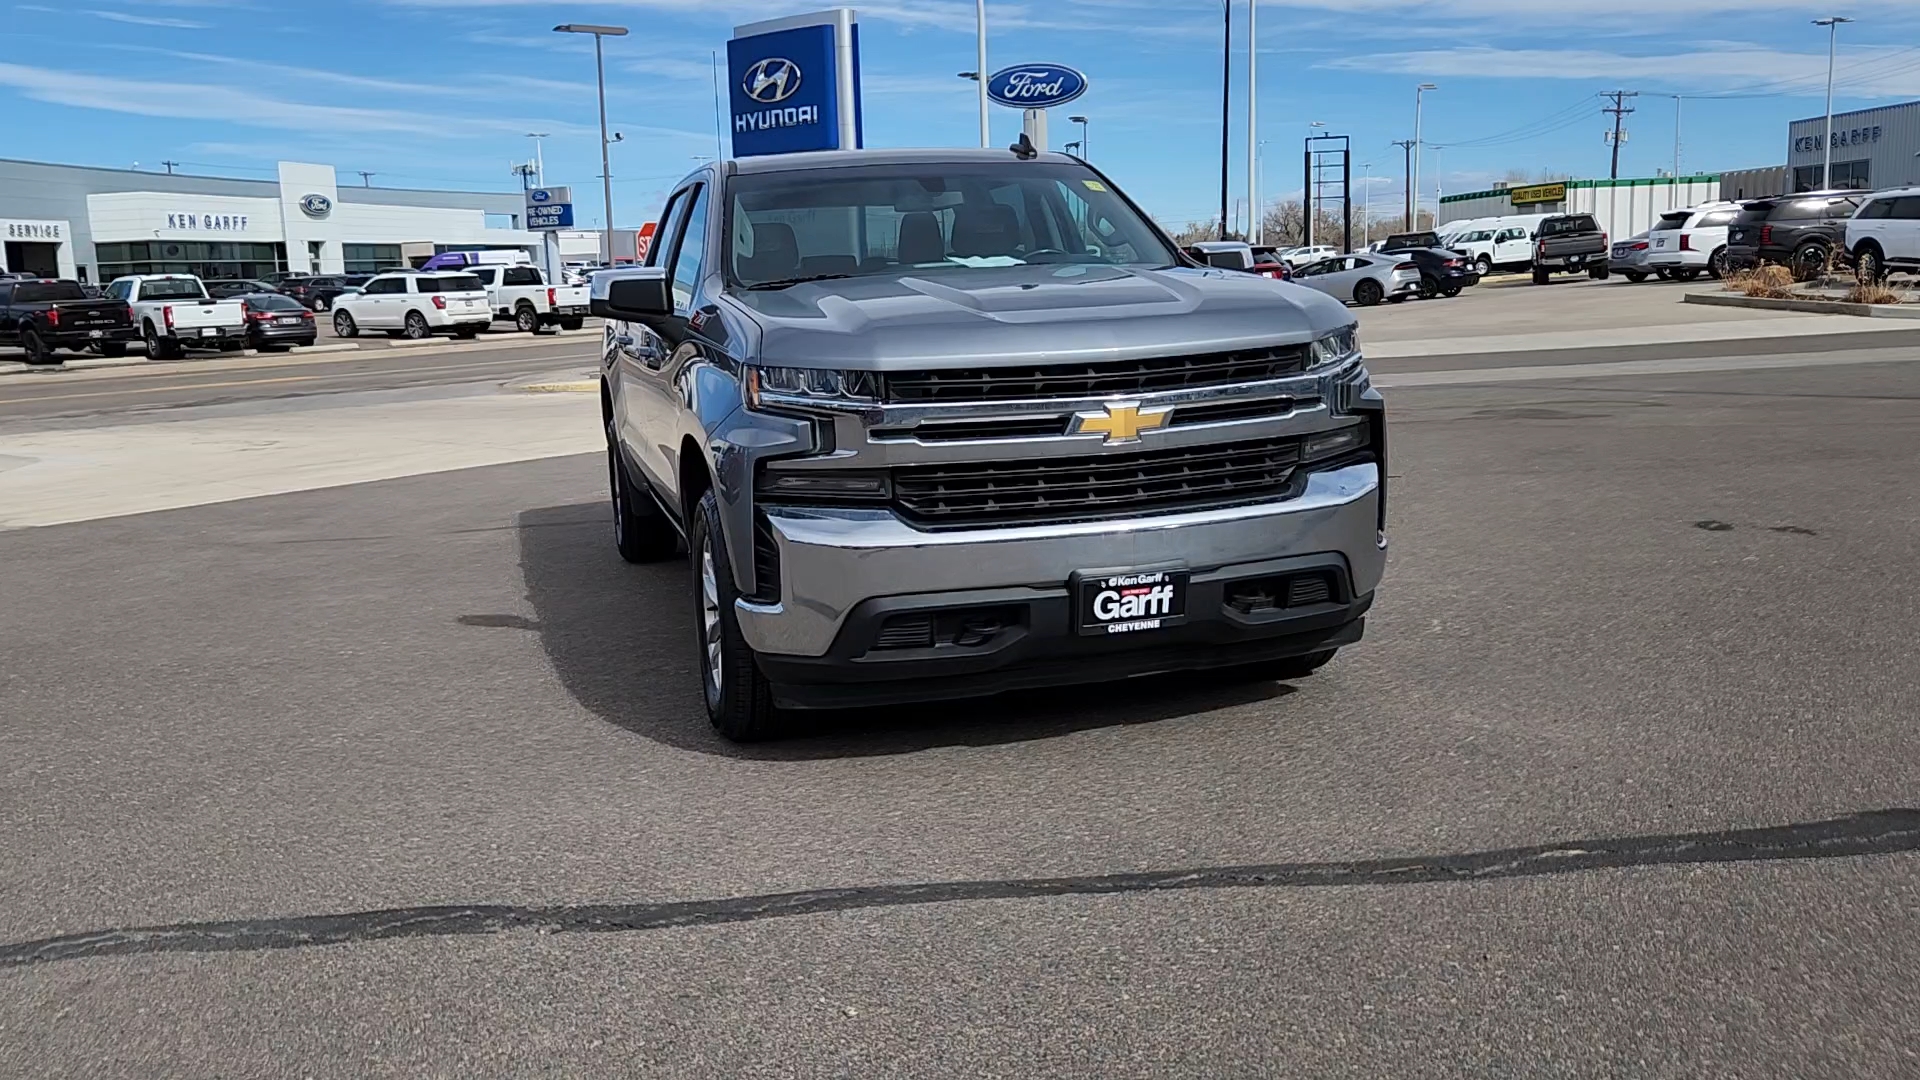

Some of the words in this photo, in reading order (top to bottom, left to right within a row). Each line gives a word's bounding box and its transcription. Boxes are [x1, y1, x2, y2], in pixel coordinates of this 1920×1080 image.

[1004, 71, 1064, 98] Ford
[735, 105, 819, 133] HYUNDAI
[1795, 134, 1824, 152] KEN
[1830, 126, 1882, 149] GARFF
[528, 206, 563, 216] PRE-OWNED
[167, 213, 197, 229] KEN
[203, 215, 248, 231] GARFF
[530, 216, 559, 226] VEHICLES
[8, 223, 60, 238] SERVICE
[1117, 576, 1137, 586] Ken
[1137, 573, 1163, 584] Garff
[1093, 585, 1173, 620] Garff
[1108, 620, 1160, 633] CHEYENNE
